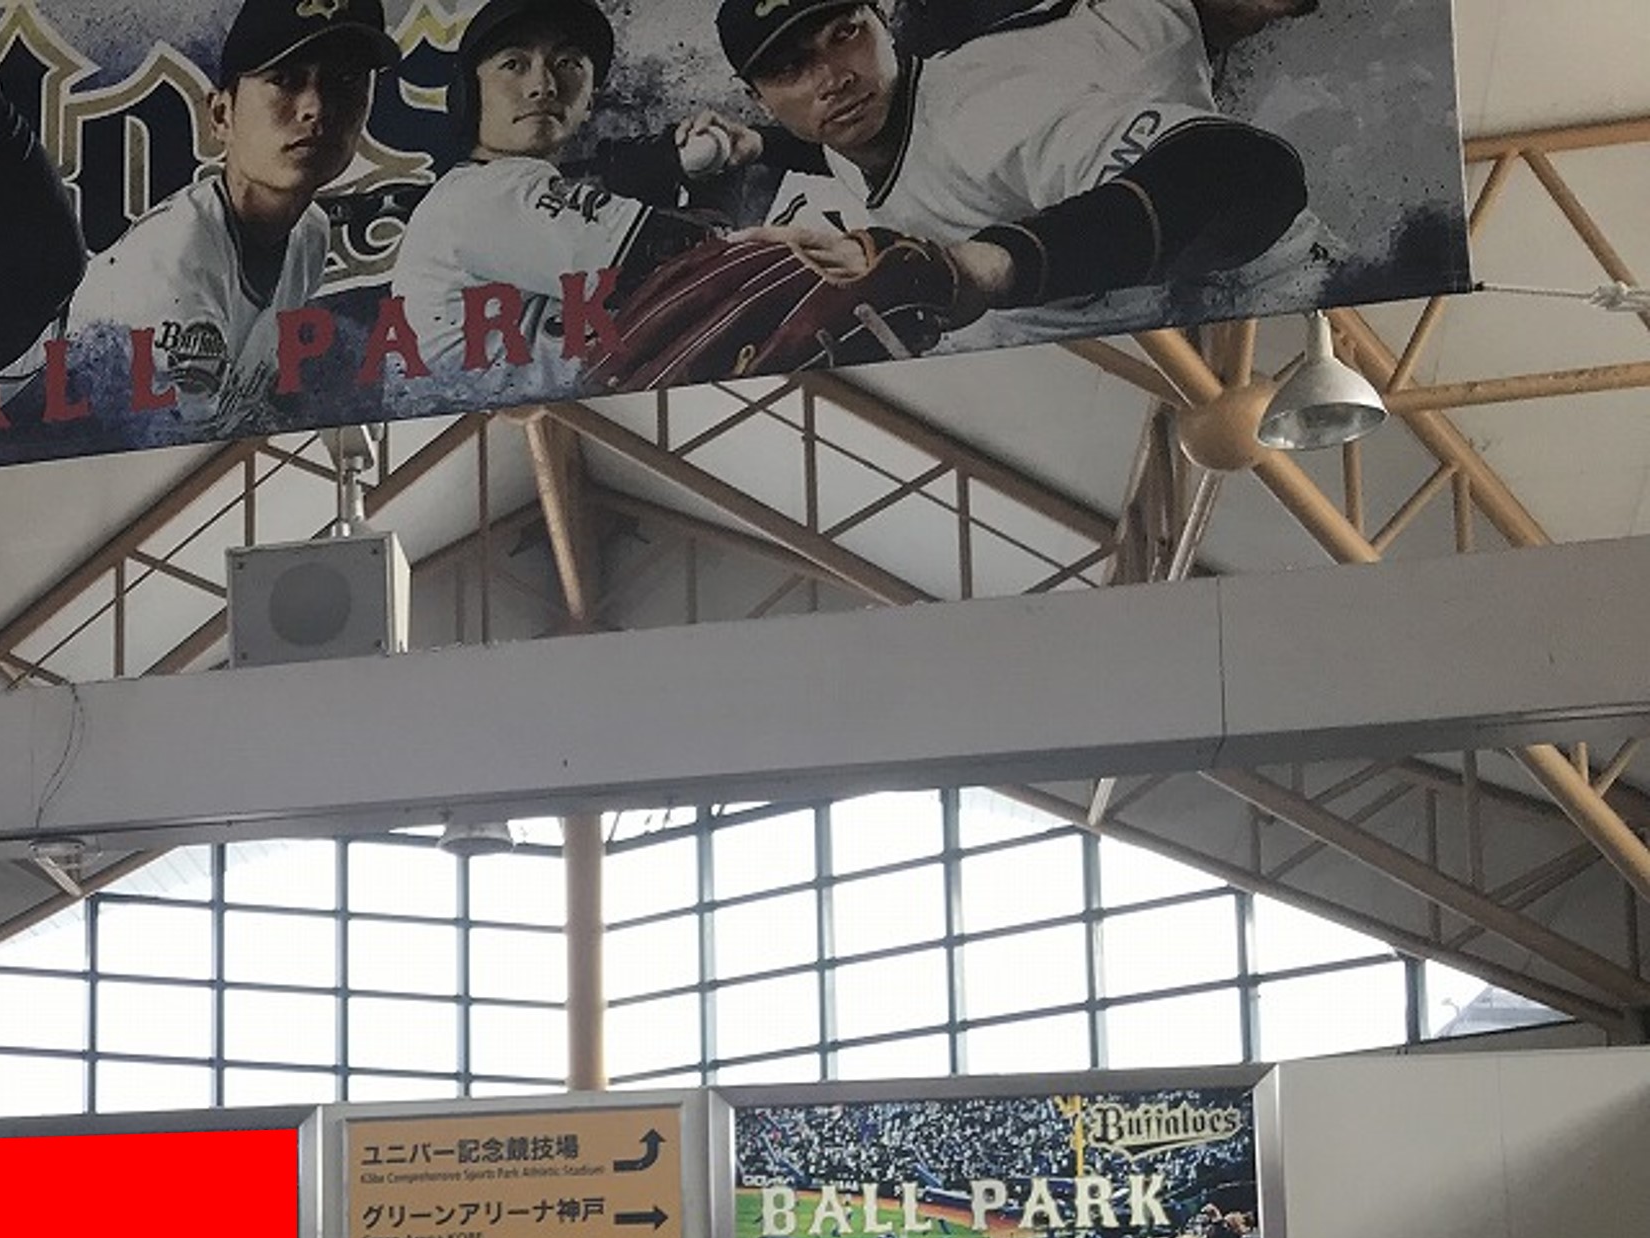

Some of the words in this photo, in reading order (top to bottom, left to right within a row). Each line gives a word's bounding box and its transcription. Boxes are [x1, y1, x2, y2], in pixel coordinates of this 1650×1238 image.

[277, 265, 628, 395] PARK
[1092, 1101, 1242, 1146] Buffaloes
[360, 1133, 580, 1167] ユニバー記念競技場
[497, 1167, 519, 1179] Park
[361, 1197, 606, 1229] グリーンアリーナ神戸
[761, 1180, 933, 1238] BALL
[969, 1173, 1171, 1232] PARK
